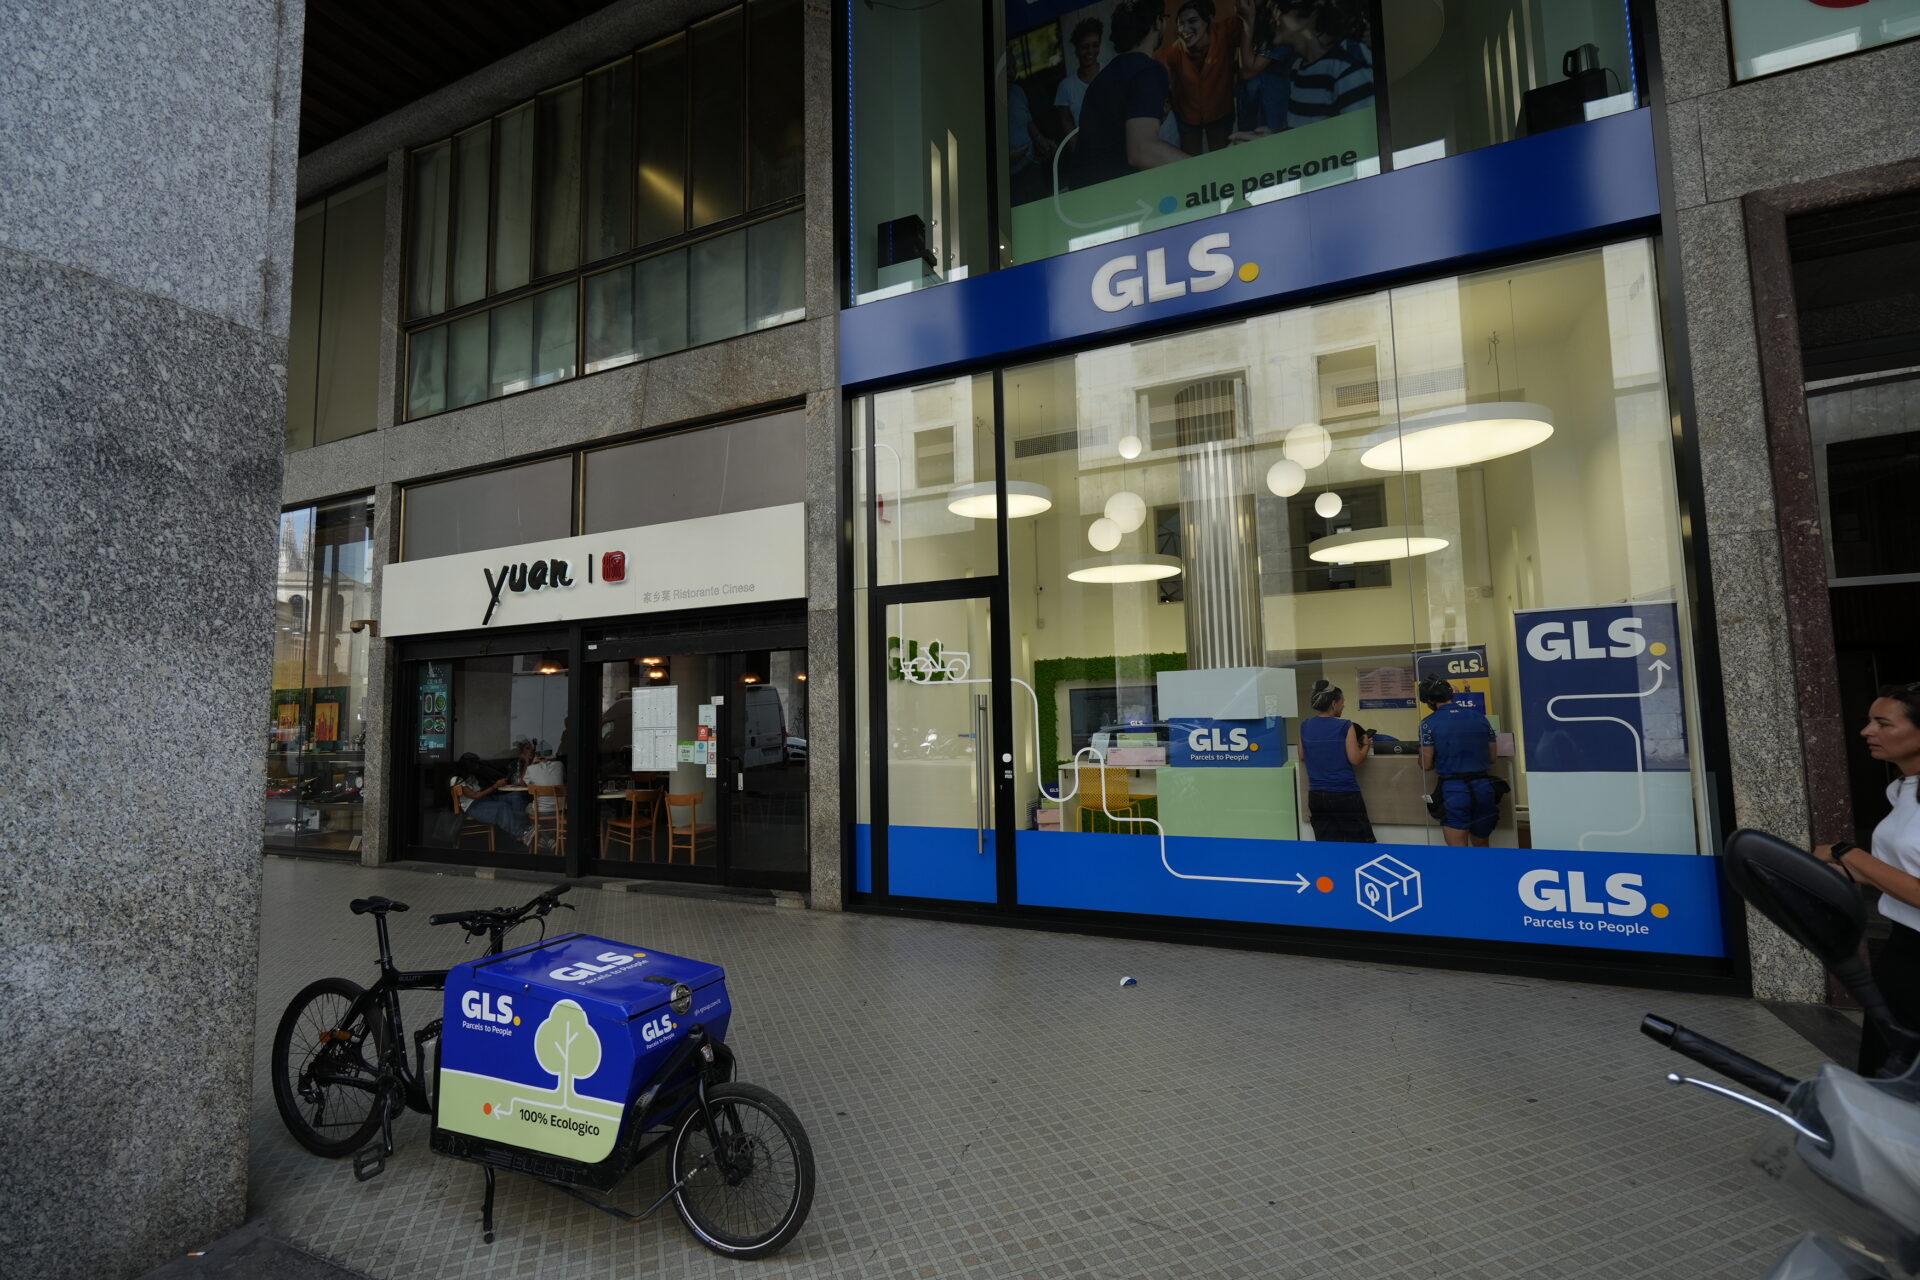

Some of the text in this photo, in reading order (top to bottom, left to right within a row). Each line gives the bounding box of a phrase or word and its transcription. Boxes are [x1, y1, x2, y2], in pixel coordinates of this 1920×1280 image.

[1186, 149, 1358, 209] alle persone
[483, 556, 574, 625] yuan
[673, 584, 720, 601] Ristorante
[722, 582, 755, 596] Cinese
[1225, 754, 1249, 762] People
[1523, 915, 1650, 936] Parcels to People
[577, 959, 649, 987] Parcels to People
[462, 1020, 513, 1038] Parcels to People
[519, 1108, 600, 1137] 100% Ecologico
